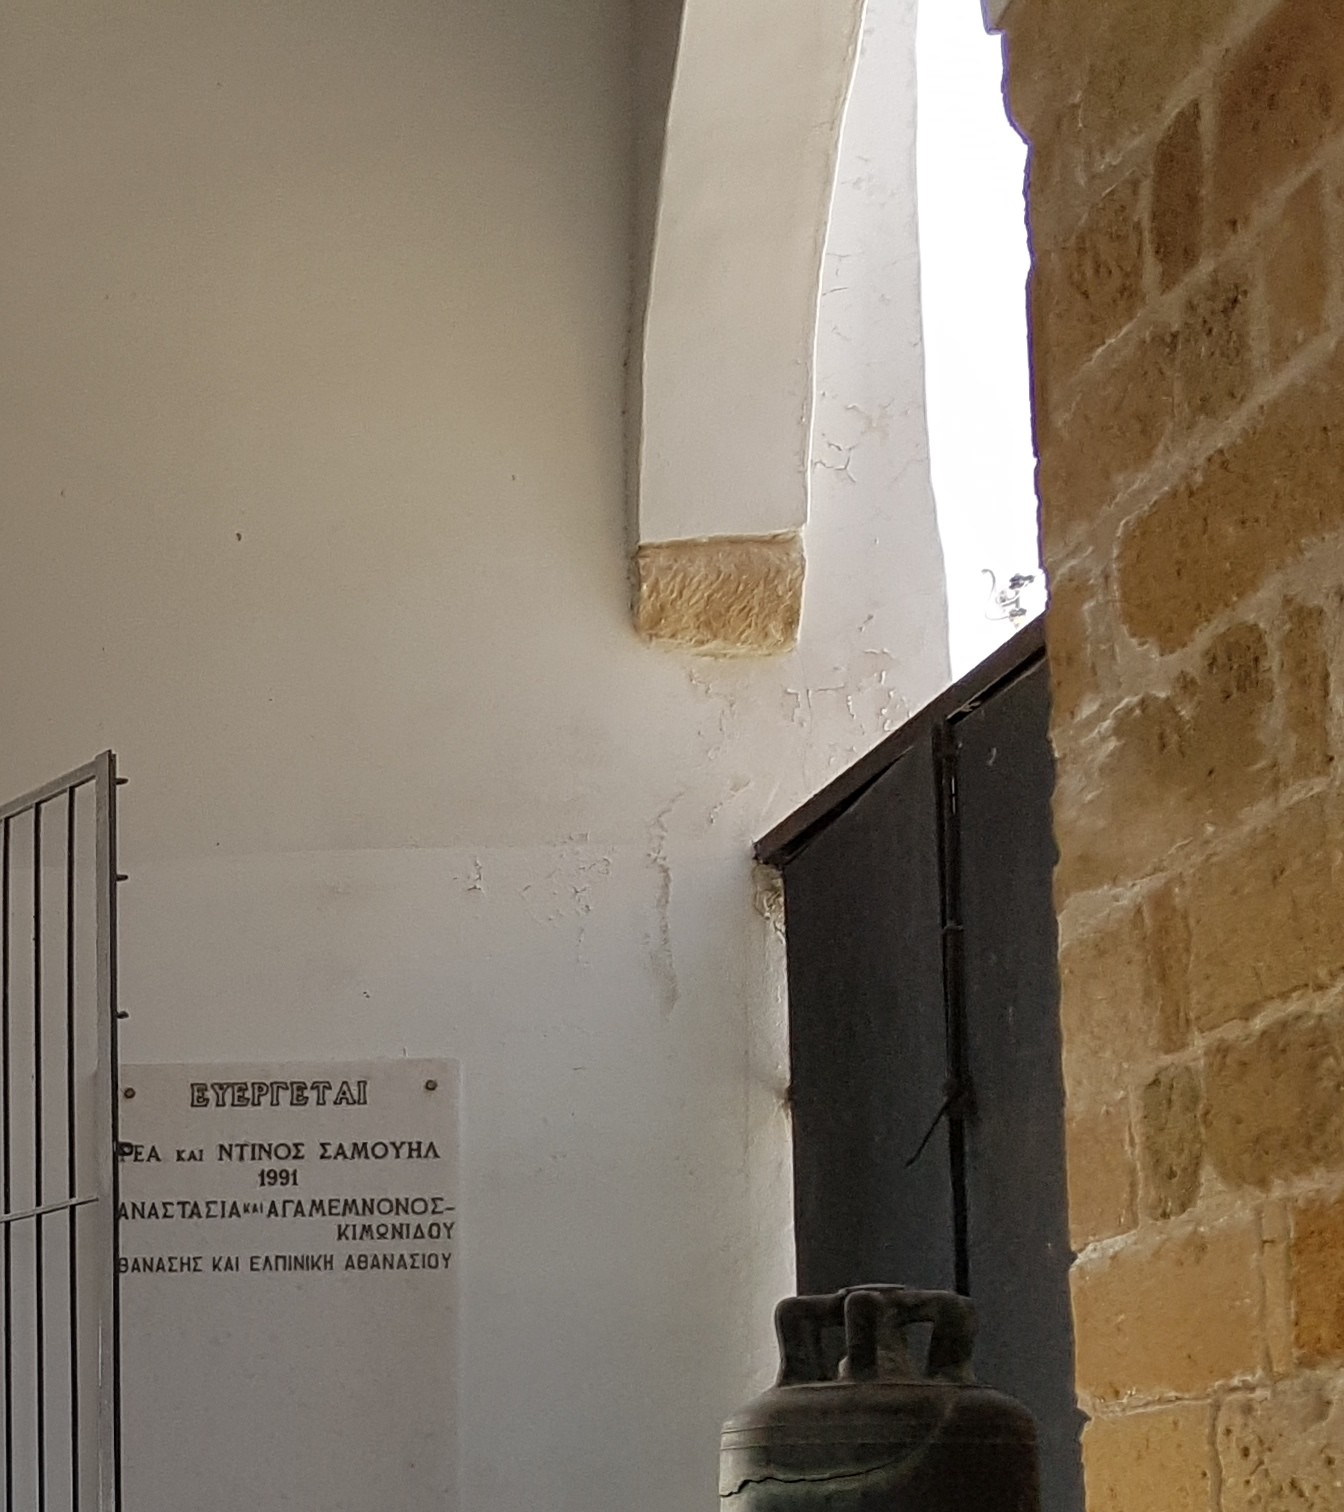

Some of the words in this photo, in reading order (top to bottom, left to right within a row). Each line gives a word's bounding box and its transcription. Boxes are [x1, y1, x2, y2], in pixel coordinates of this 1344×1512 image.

[190, 1080, 368, 1107] ΕΥΕΡΓΕΤΑΙ
[218, 1142, 306, 1162] ΝΤΙΝΟΣ
[319, 1141, 441, 1161] ΣΑΜΟΥΗΛ
[258, 1168, 299, 1187] 1991
[118, 1200, 241, 1220] ΑΝΑΣΤΑΣΙΑ
[336, 1221, 456, 1241] ΚΙΜΩΝΙΔΟΥ
[118, 1255, 203, 1274] ΘΑΝΑΣΗΣ
[212, 1255, 240, 1273] ΚΑΙ
[249, 1253, 334, 1273] ΕΛΠΙΝΙΚΗ
[344, 1252, 452, 1271] ΑΘΑΝΑΣΙΟΥ
